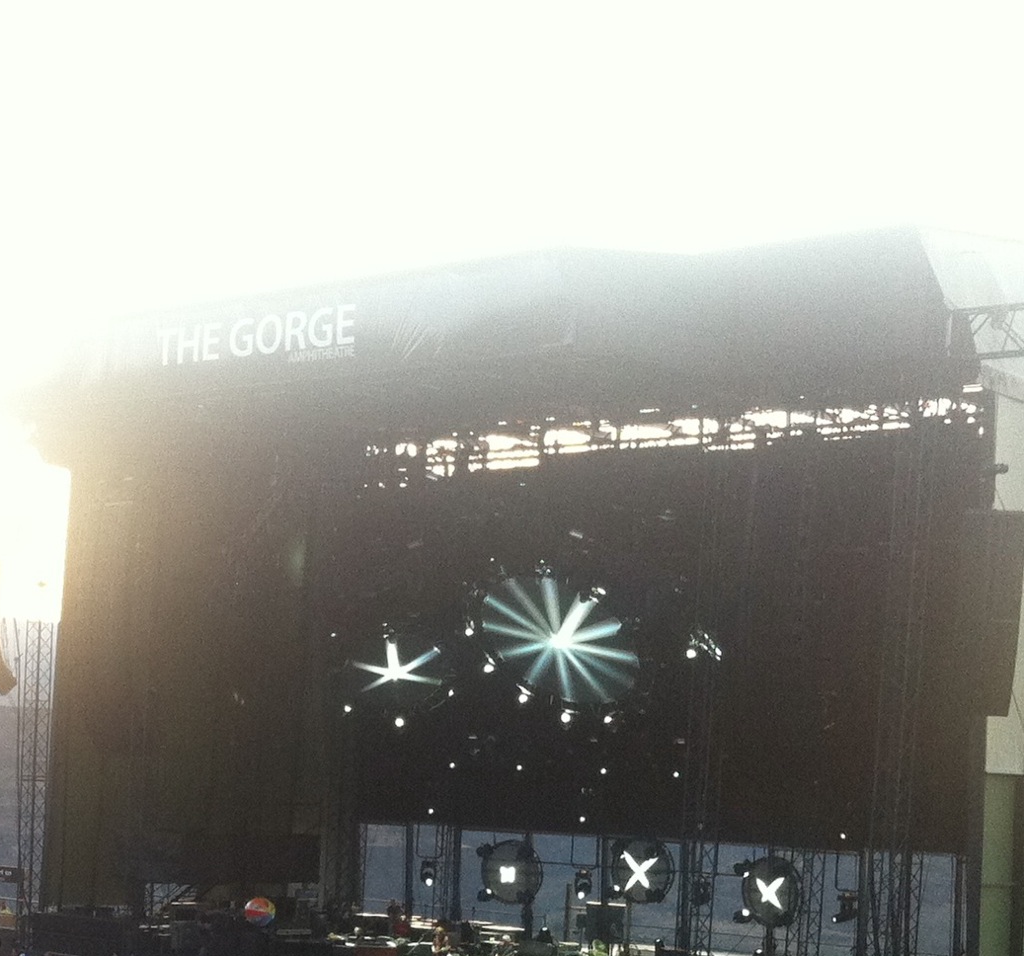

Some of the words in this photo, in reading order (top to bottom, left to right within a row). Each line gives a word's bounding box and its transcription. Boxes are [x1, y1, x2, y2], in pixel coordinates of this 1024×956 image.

[156, 321, 221, 366] THE
[228, 303, 357, 358] GORGE
[287, 344, 356, 363] AMPHITHEATRE
